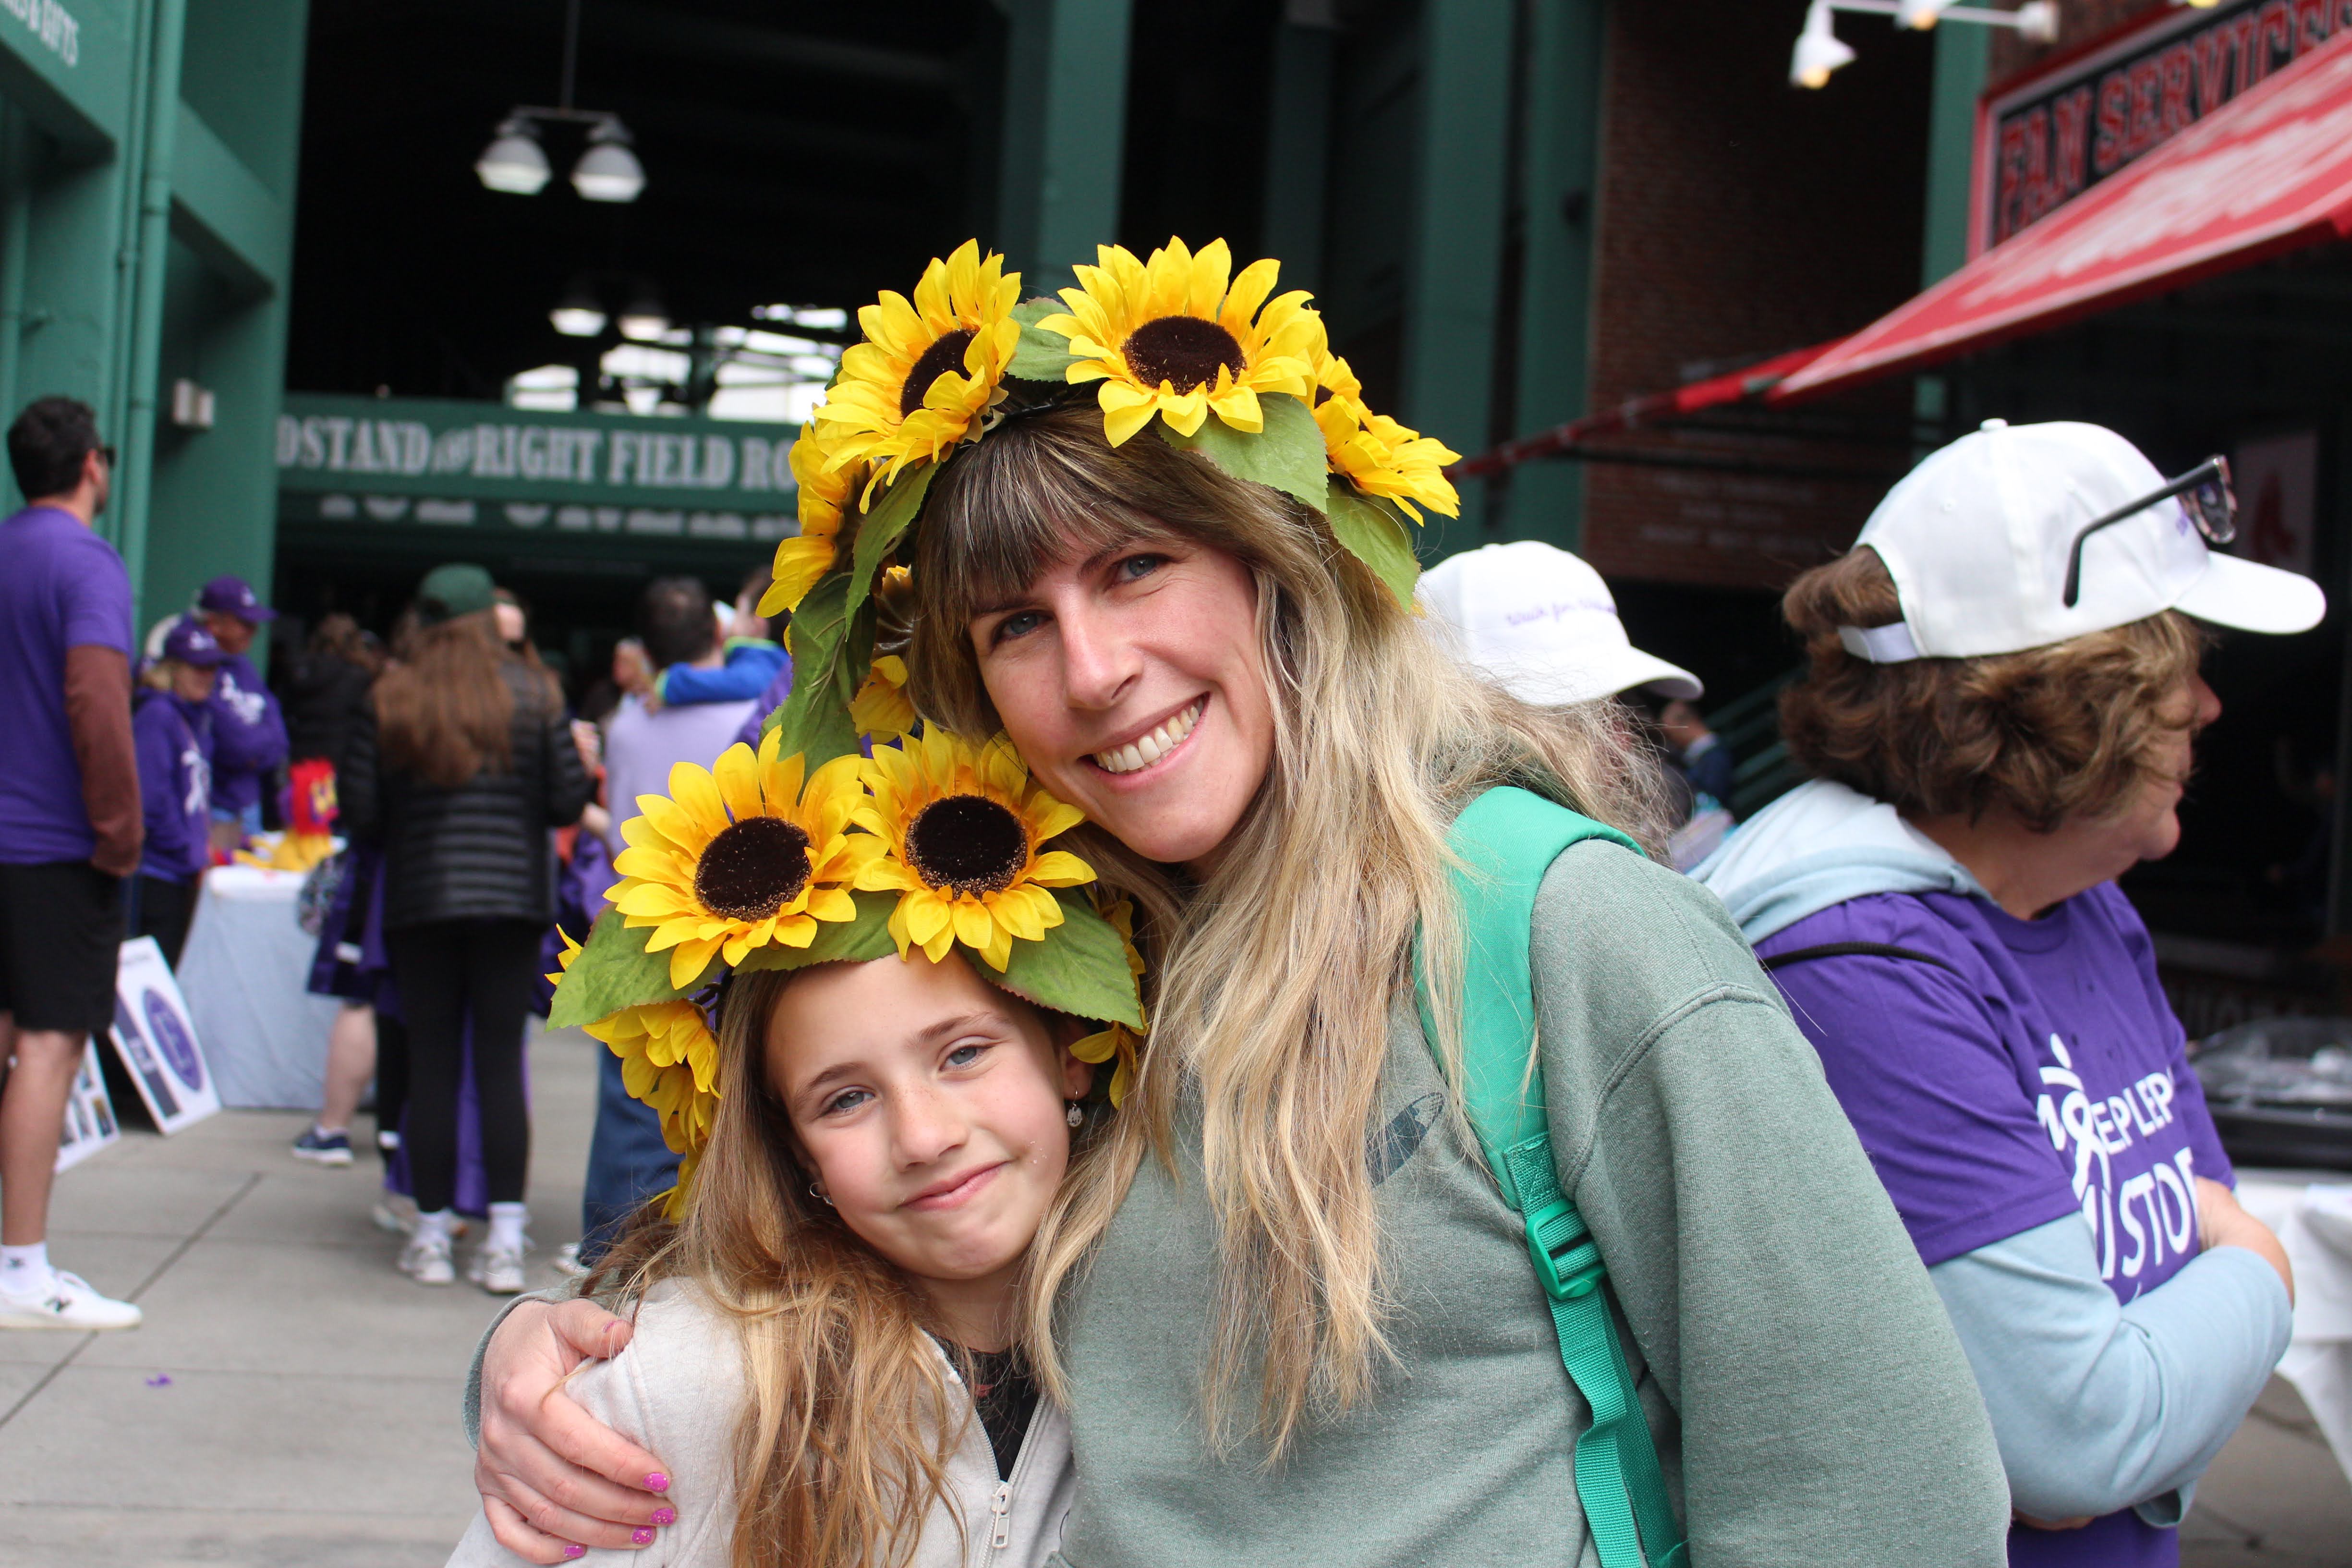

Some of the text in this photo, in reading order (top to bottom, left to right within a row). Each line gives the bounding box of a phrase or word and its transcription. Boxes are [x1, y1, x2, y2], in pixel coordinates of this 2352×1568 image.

[1999, 87, 2092, 196] FAN
[472, 424, 602, 482] RIGHT
[606, 430, 734, 489] FIELD
